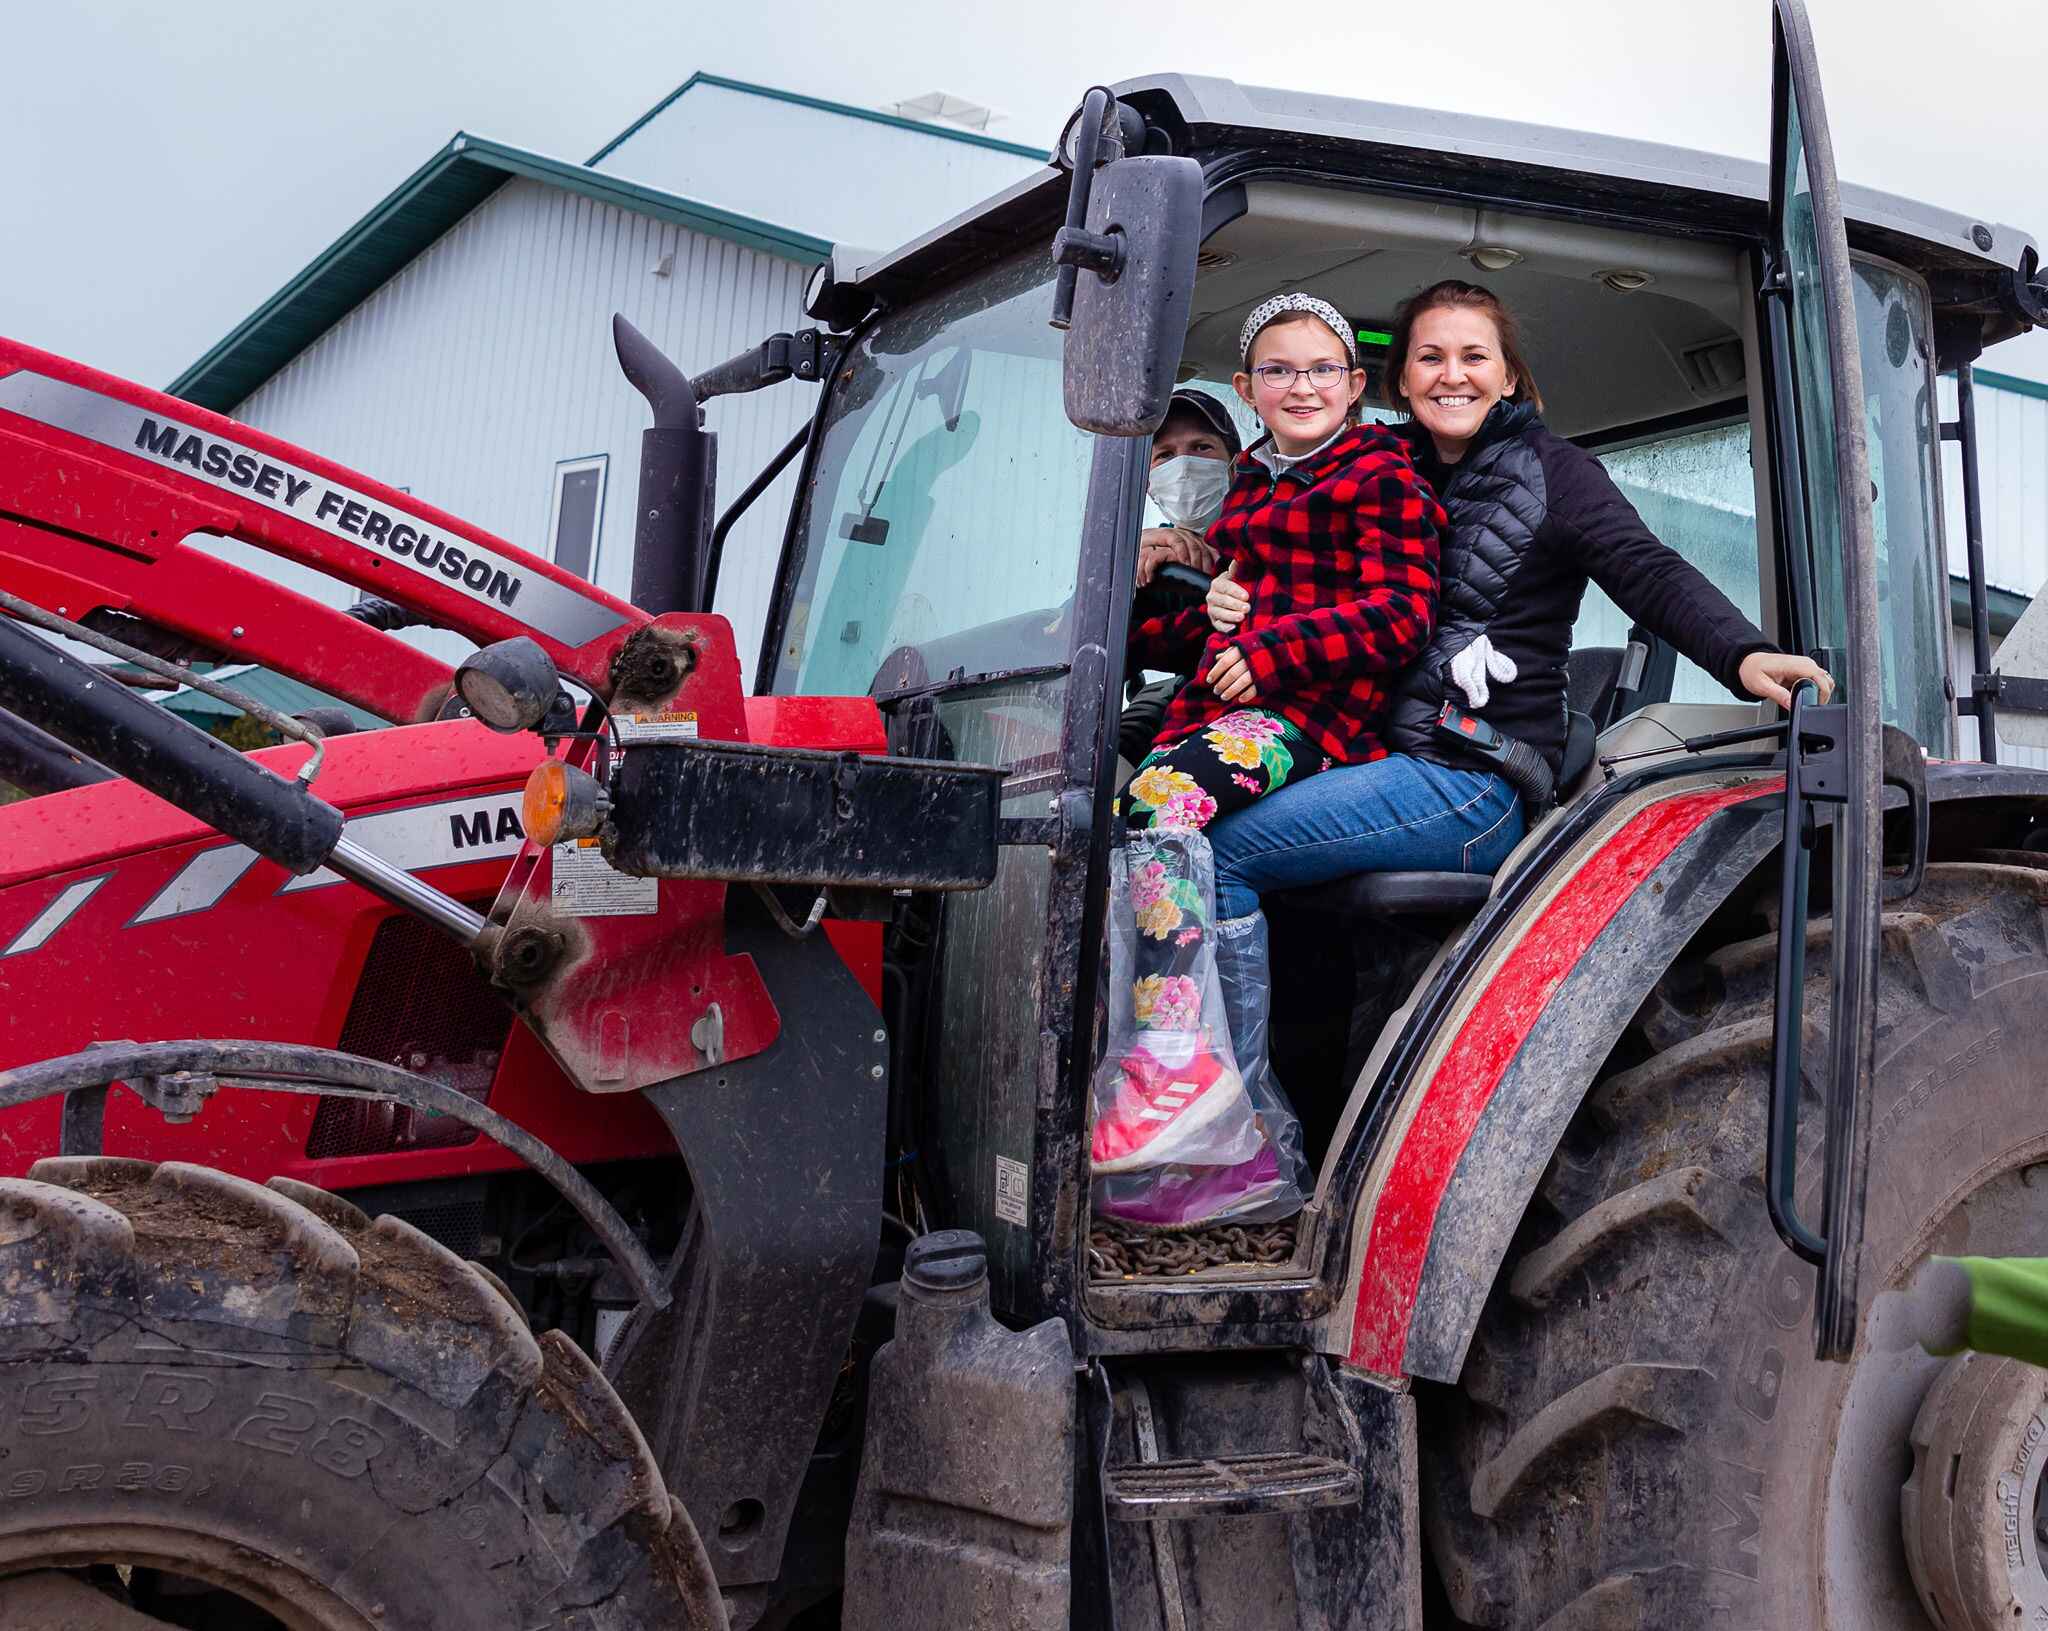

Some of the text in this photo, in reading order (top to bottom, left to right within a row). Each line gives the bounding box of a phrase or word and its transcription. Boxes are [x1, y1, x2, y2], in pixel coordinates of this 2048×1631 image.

[133, 418, 522, 608] MASSEY FERGUSON
[449, 806, 526, 849] MA
[0, 1370, 387, 1478] 5 R 28
[56, 1464, 105, 1493] R
[2004, 1493, 2020, 1569] WEIGHT
